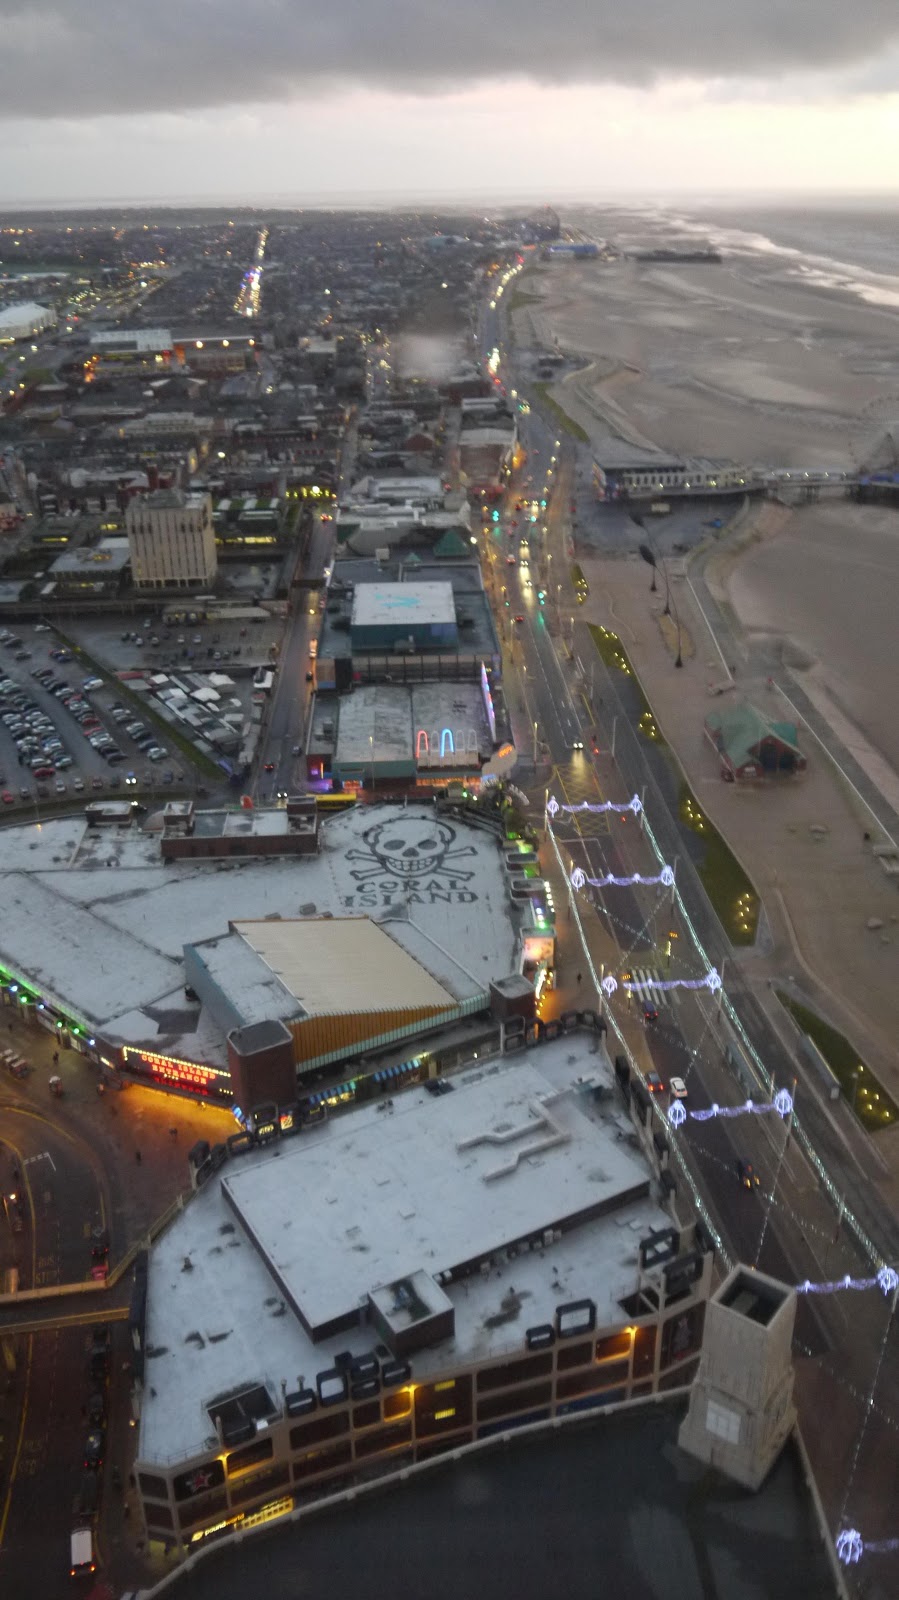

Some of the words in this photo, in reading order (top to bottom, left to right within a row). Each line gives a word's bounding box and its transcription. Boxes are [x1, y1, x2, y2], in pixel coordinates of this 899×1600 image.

[356, 879, 470, 894] CORAL
[344, 891, 479, 907] ISLAND
[142, 1054, 174, 1069] CORAL
[178, 1064, 216, 1080] ISLAND
[151, 1064, 207, 1085] ENTRANCE
